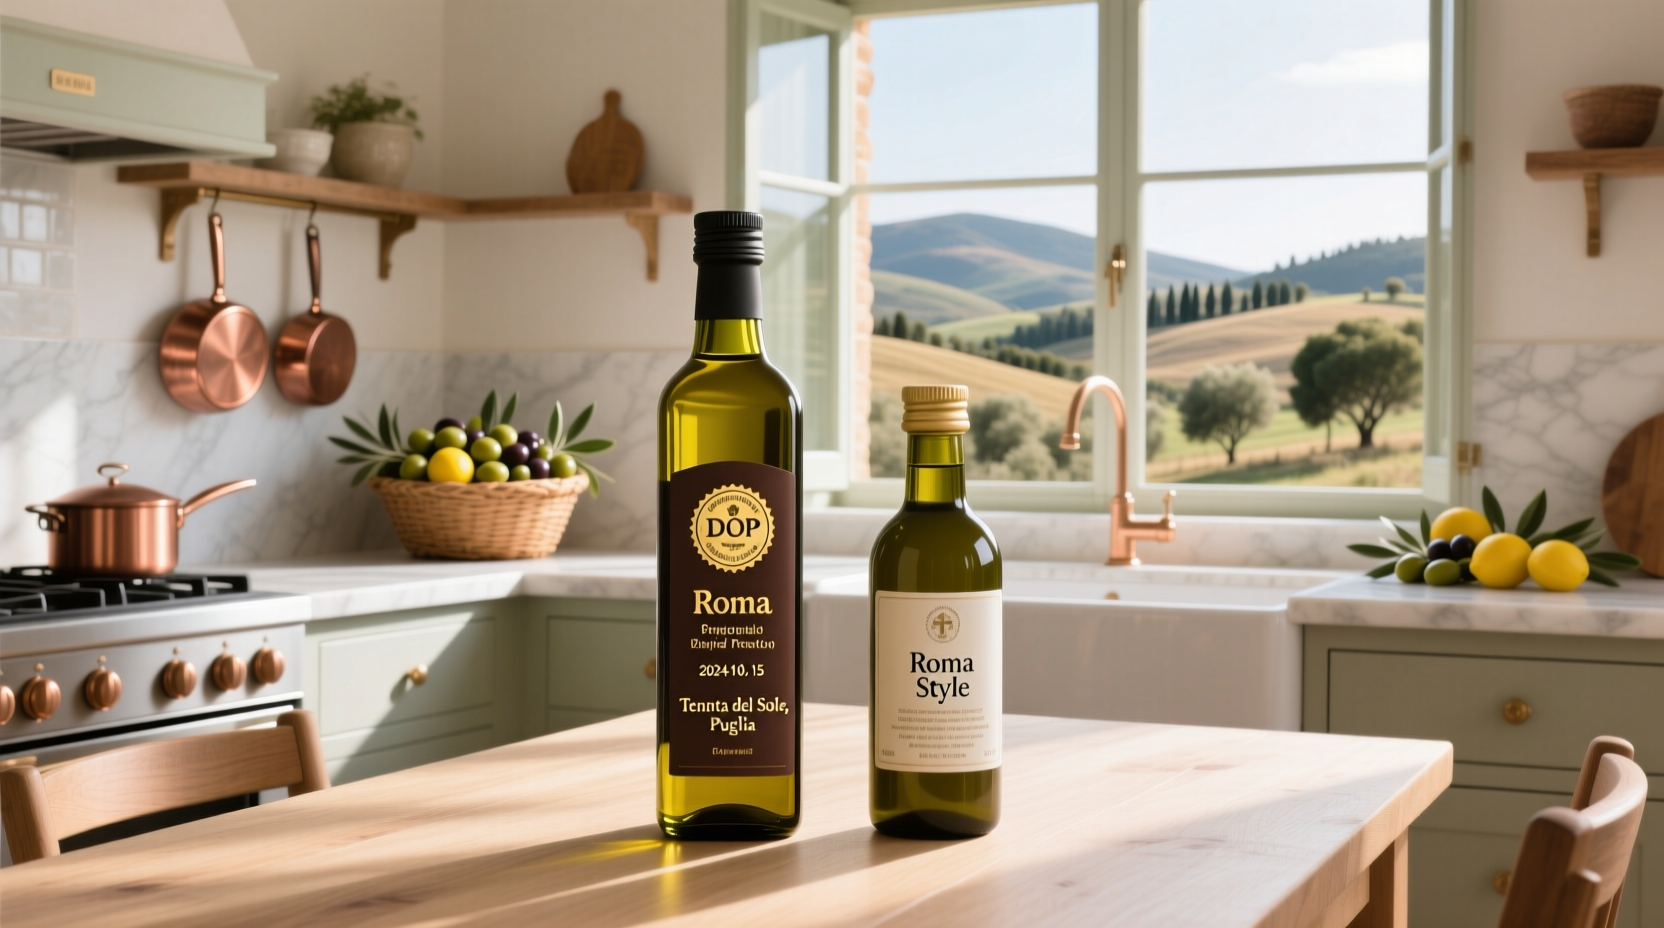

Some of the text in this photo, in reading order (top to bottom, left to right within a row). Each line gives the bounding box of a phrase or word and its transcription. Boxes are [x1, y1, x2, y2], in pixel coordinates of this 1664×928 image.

[706, 517, 761, 538] DOP
[693, 589, 773, 615] Roma
[910, 651, 974, 673] Roma
[916, 676, 970, 704] Style
[732, 696, 753, 713] del
[757, 696, 789, 715] Sole,
[710, 715, 756, 736] Puglia
